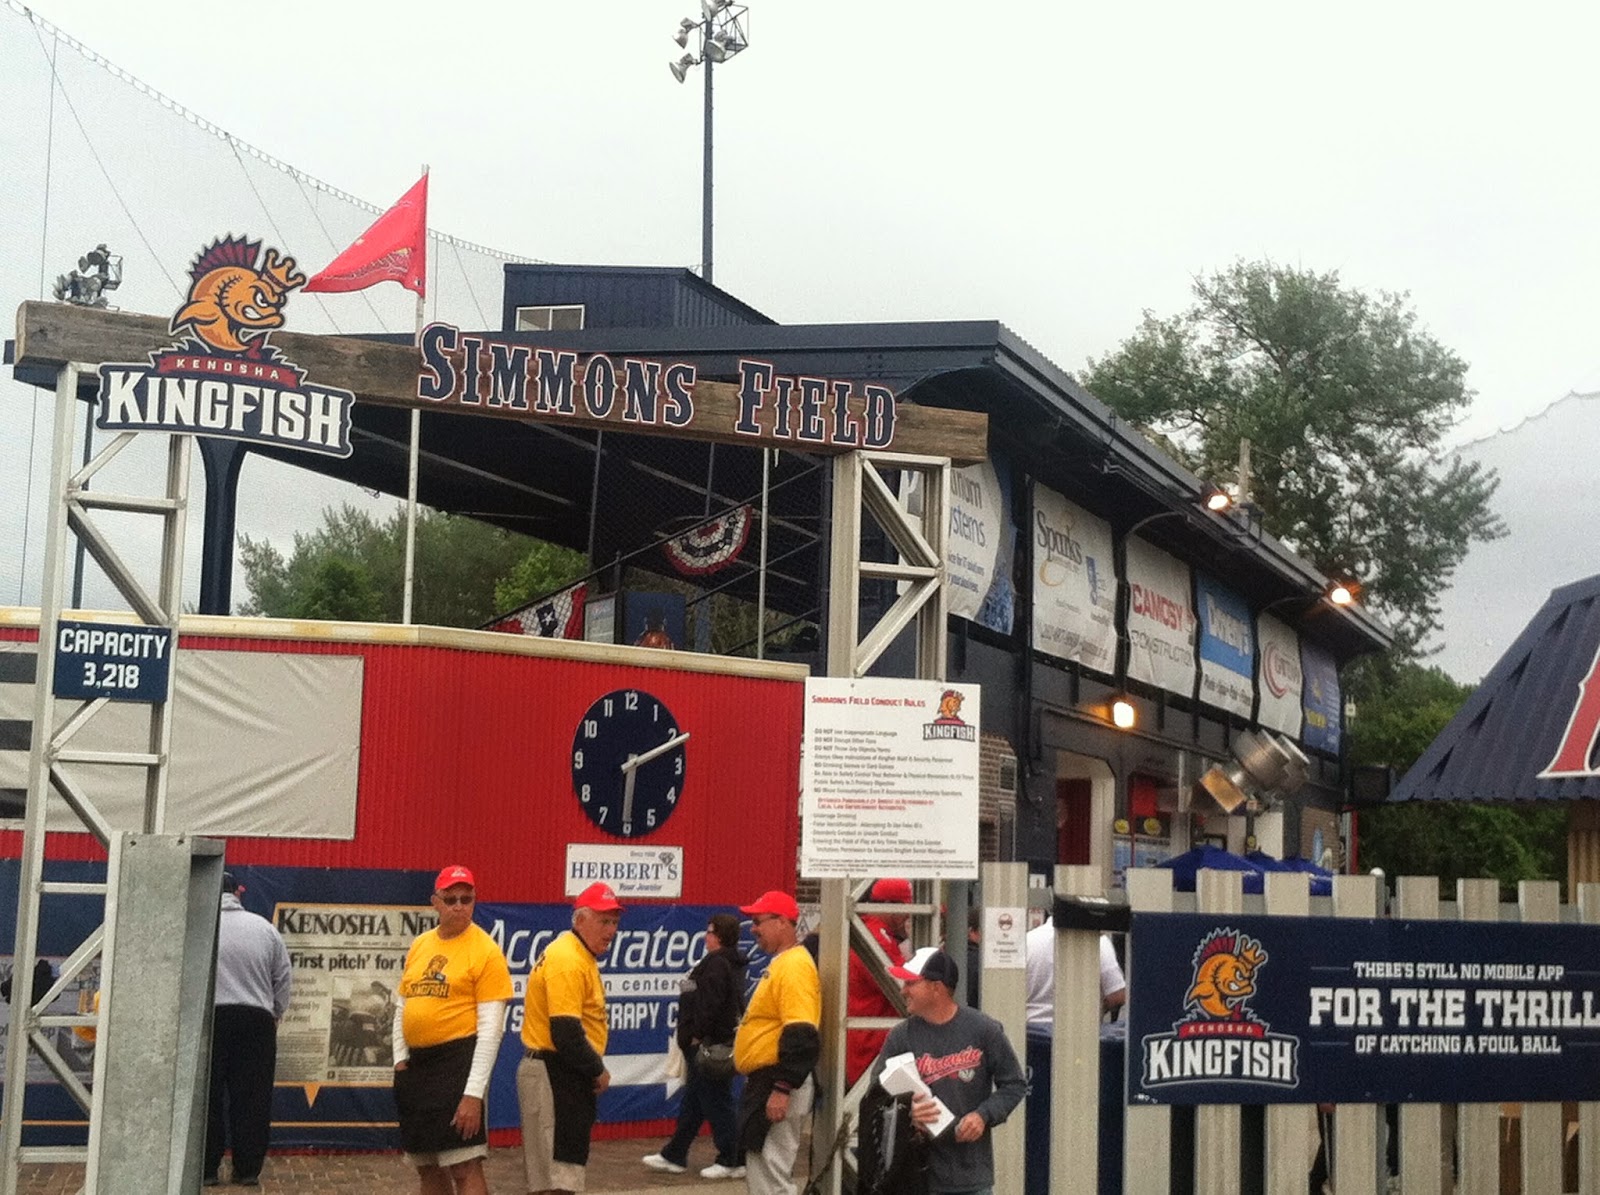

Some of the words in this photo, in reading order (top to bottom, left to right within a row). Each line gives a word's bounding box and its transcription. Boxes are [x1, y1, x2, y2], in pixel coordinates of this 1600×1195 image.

[176, 357, 281, 381] KENOSHA
[417, 322, 697, 427] SIMMONS
[735, 358, 898, 449] FIELD
[104, 371, 345, 450] KINGFISH
[1036, 510, 1083, 565] Sparks
[59, 628, 168, 659] CAPACITY
[83, 661, 140, 689] 3,218
[604, 699, 613, 717] 11
[625, 692, 638, 710] 12
[812, 695, 848, 704] SIMMONS
[849, 696, 870, 705] FIELD
[871, 697, 902, 706] CONDUCT
[904, 698, 926, 707] RULES
[653, 704, 658, 721] 1
[585, 720, 597, 738] 10
[925, 725, 974, 739] KINGFISH
[575, 752, 583, 769] 9
[675, 758, 682, 775] 3
[581, 784, 591, 802] 8
[667, 786, 676, 804] 4
[600, 806, 608, 825] 7
[647, 809, 655, 827] 5
[619, 883, 635, 891] Your
[278, 908, 390, 936] KENOSHA
[376, 954, 398, 969] for
[1354, 961, 1414, 978] THERE'S
[1417, 963, 1457, 979] STILL
[1460, 964, 1481, 980] NO
[1483, 964, 1535, 980] MOBILE
[1538, 965, 1565, 981] APP
[622, 975, 676, 992] center
[1309, 987, 1383, 1026] FOR
[1390, 988, 1466, 1027] THE
[1475, 989, 1600, 1027] THRILL
[1188, 1023, 1254, 1034] KENOSHA
[1355, 1034, 1378, 1053] OF
[1380, 1034, 1463, 1053] CATCHING
[1463, 1036, 1477, 1052] A
[1478, 1035, 1518, 1053] FOUL
[1521, 1036, 1561, 1053] BALL
[1149, 1039, 1292, 1081] KINGFISH
